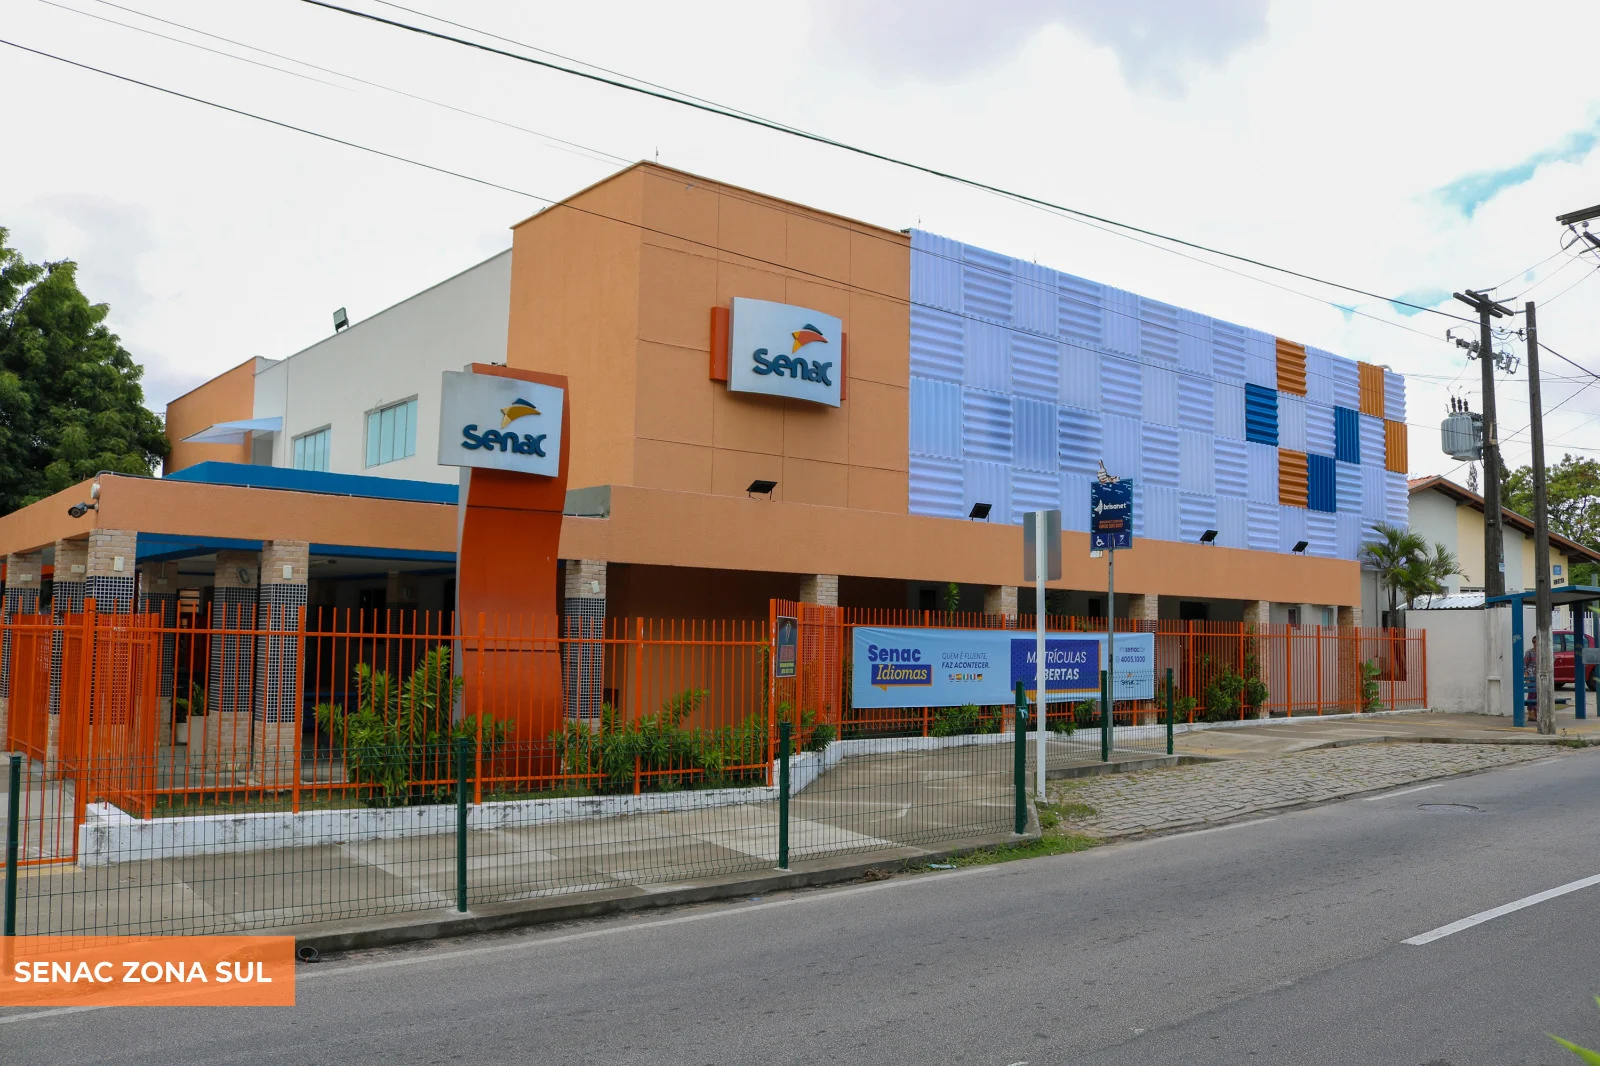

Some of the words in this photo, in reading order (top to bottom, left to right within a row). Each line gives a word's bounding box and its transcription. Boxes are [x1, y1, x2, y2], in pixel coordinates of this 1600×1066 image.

[868, 644, 921, 662] Senac
[941, 652, 958, 660] QUEM
[960, 651, 964, 660] É
[964, 652, 988, 660] FLUENTE,
[1026, 648, 1087, 663] MTRÍCULAS
[876, 663, 928, 680] Idiomas
[954, 661, 990, 669] ACONTECER.
[1034, 668, 1080, 681] BERTAS
